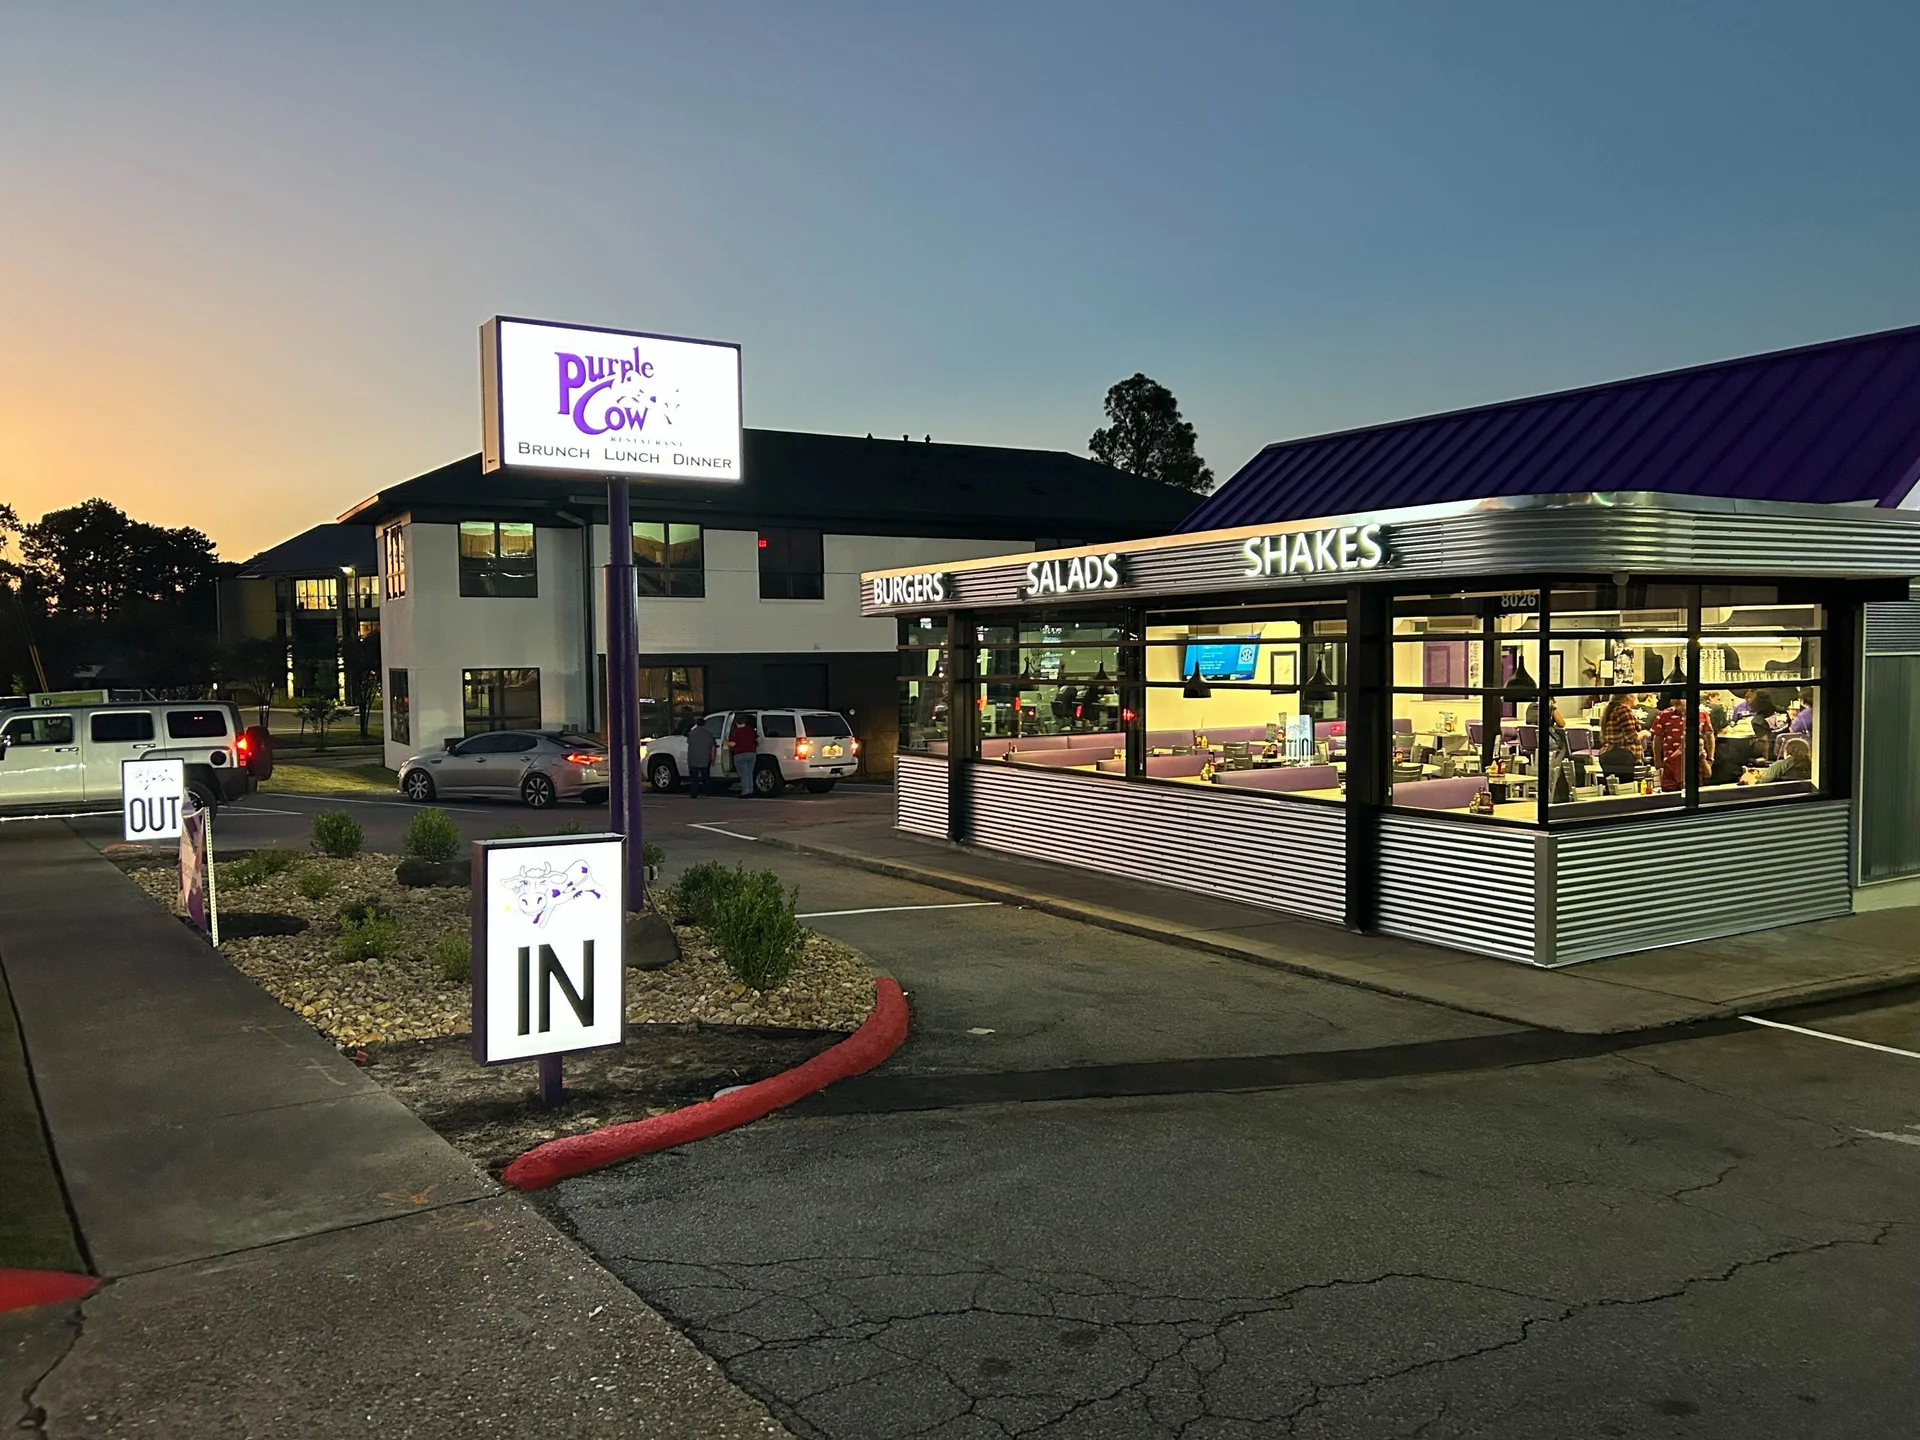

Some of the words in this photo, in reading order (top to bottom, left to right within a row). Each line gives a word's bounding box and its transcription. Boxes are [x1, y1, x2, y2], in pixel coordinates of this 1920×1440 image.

[573, 379, 648, 435] Cow
[1244, 523, 1381, 576] SHAKES
[873, 572, 944, 604] BURGERS
[1026, 553, 1118, 595] SALADS
[1501, 593, 1537, 608] 8026
[129, 796, 180, 833] OUT
[518, 939, 594, 1036] IN
